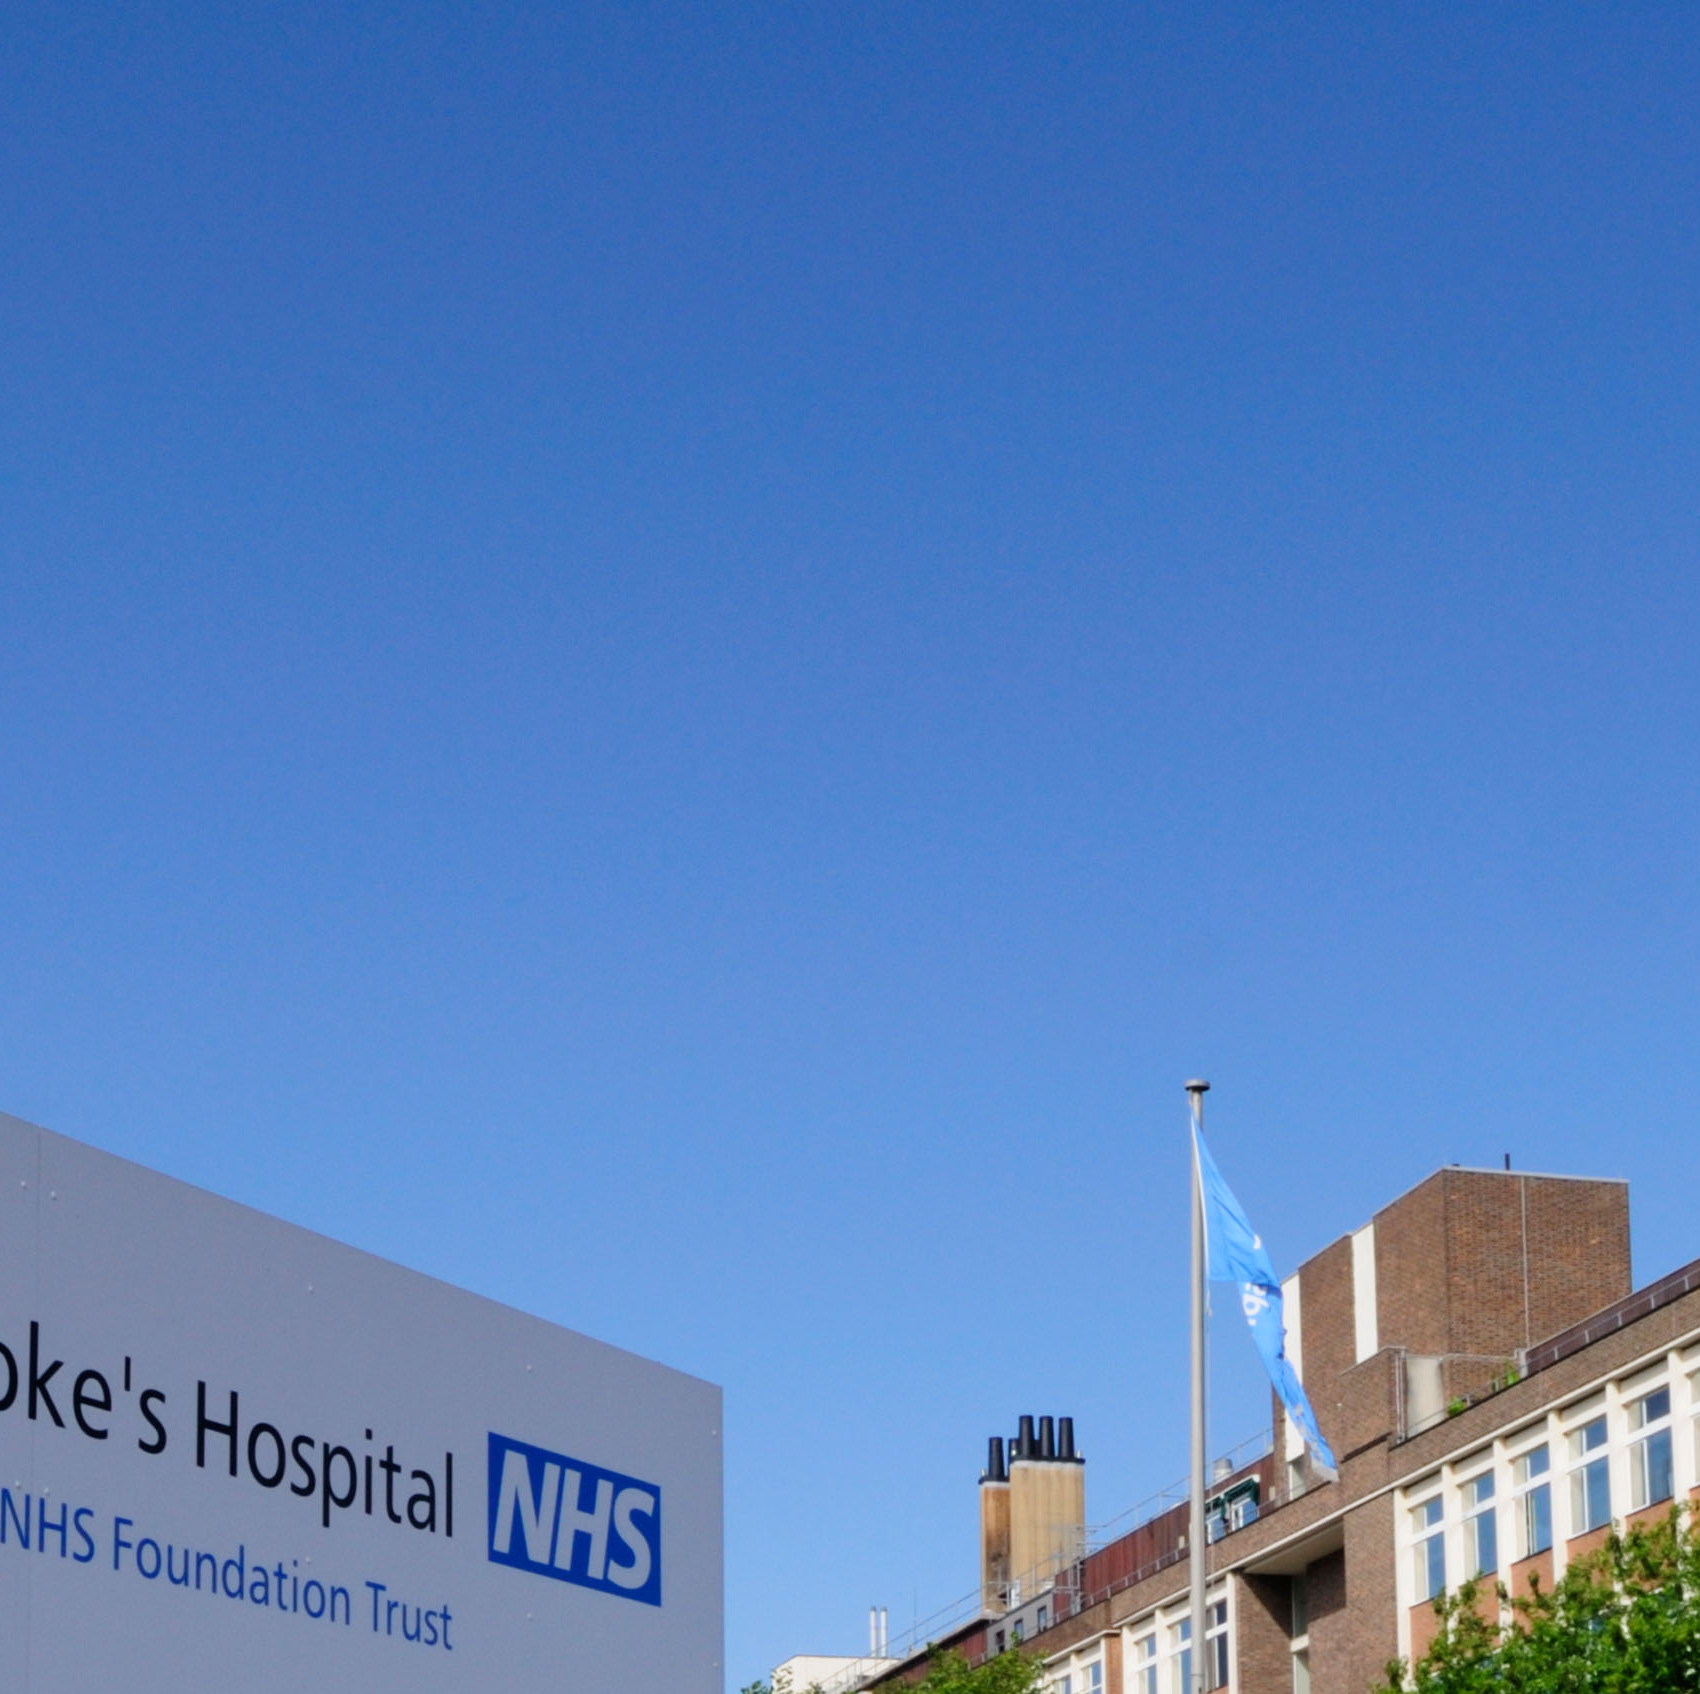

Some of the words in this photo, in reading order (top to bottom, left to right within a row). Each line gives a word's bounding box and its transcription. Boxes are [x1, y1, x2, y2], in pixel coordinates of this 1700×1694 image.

[195, 1380, 454, 1538] Hospital
[492, 1448, 656, 1590] NHS
[110, 1513, 354, 1626] Foundation
[362, 1577, 454, 1654] Trust
